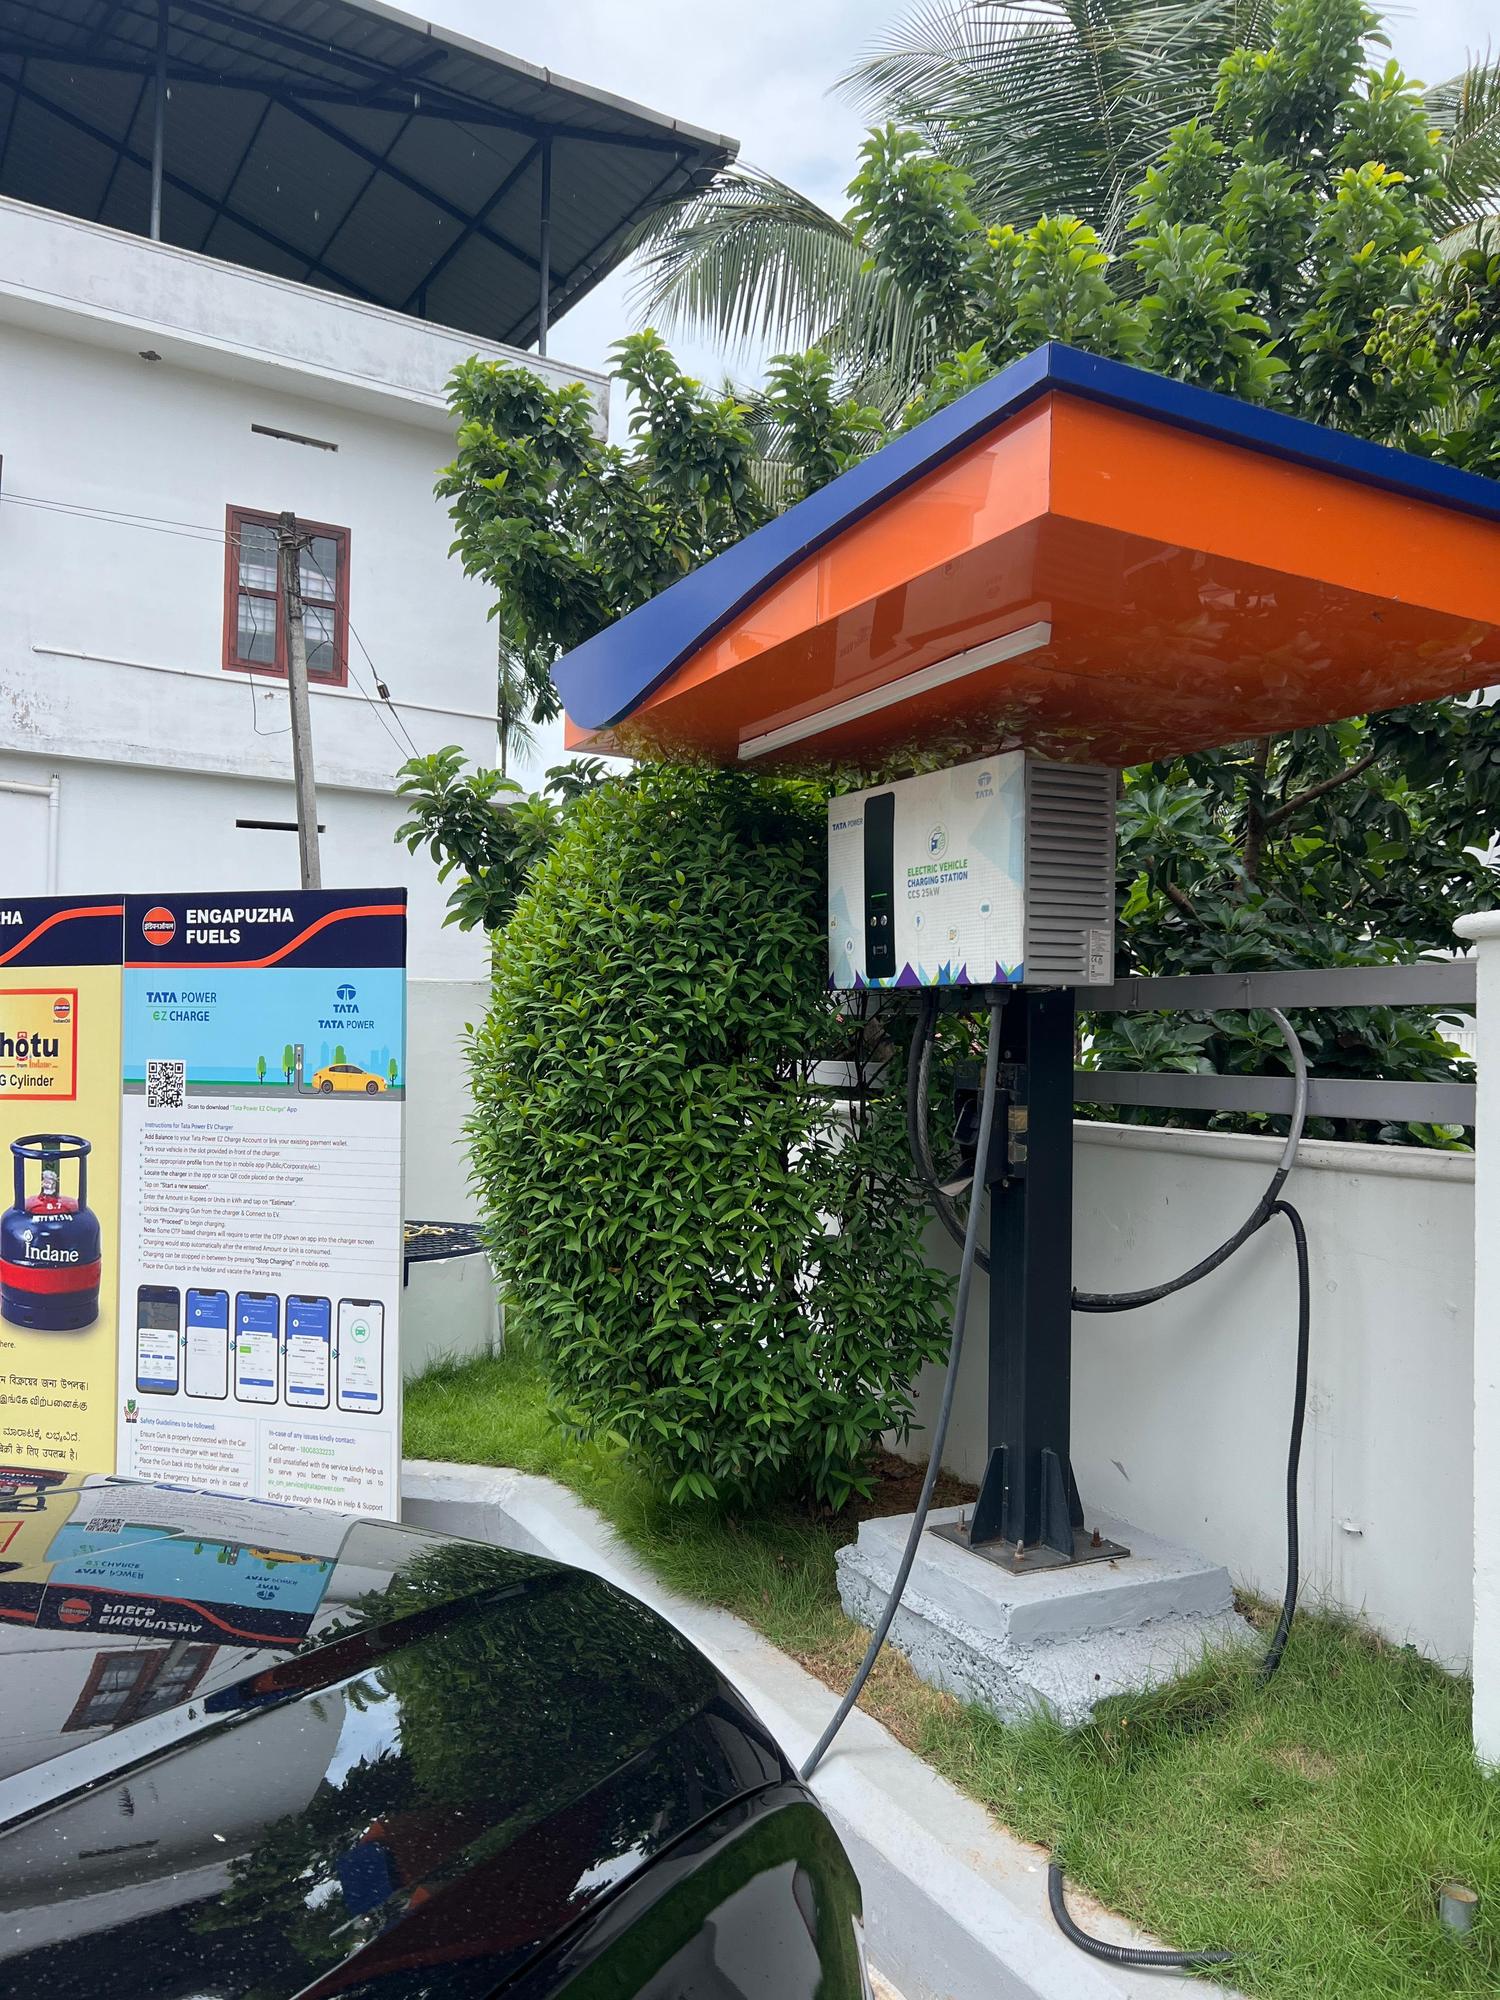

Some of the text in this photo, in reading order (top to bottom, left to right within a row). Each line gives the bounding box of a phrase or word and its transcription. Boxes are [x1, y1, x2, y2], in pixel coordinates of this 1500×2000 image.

[975, 788, 994, 799] TATA
[832, 818, 863, 831] TATA POWER
[908, 859, 968, 877] ELECTRIC VEHICLE
[908, 871, 968, 888] CHARGING STATION
[908, 888, 940, 899] CCS 25kW
[0, 911, 23, 925] HA
[186, 908, 294, 924] ENGAPUZHA
[186, 929, 241, 944] FUELS
[146, 992, 217, 1003] TATA POWER
[333, 1004, 359, 1014] TATA
[170, 1010, 210, 1022] CHARGE
[318, 1020, 374, 1029] TATA POWER
[10, 1074, 54, 1090] Cylinder
[24, 1242, 79, 1262] Indane
